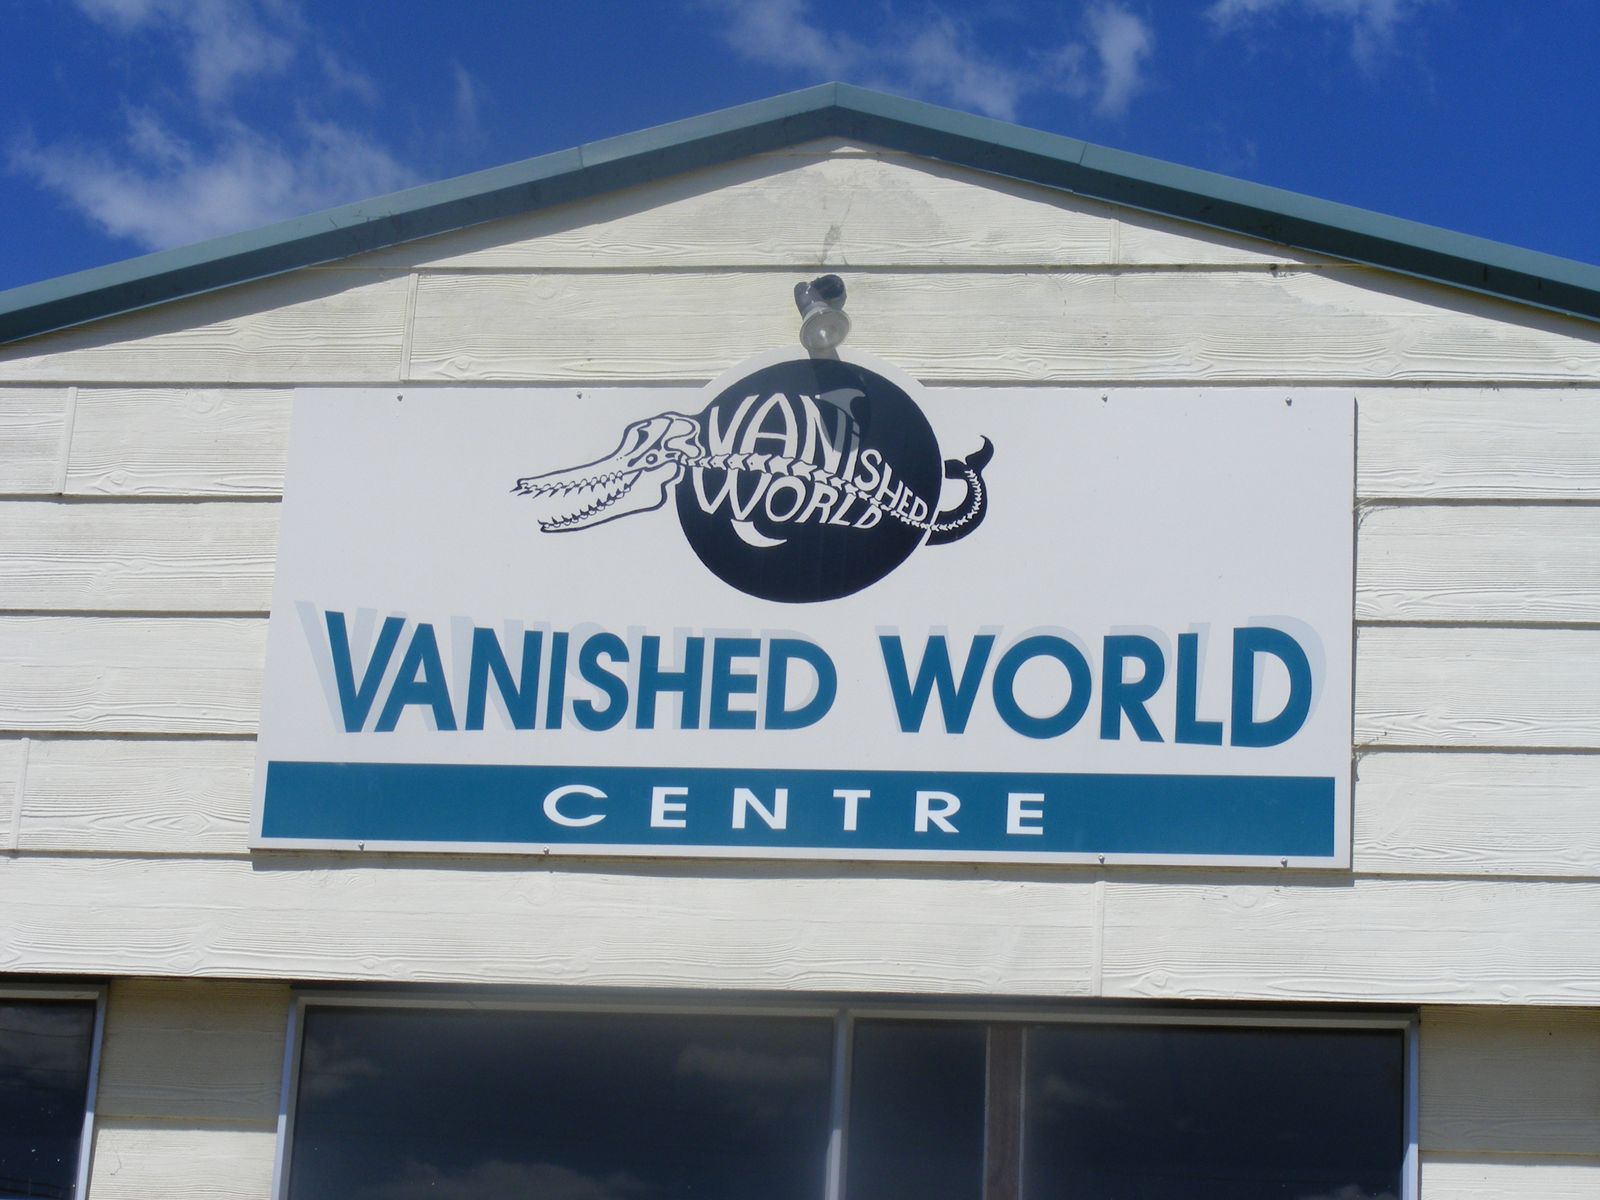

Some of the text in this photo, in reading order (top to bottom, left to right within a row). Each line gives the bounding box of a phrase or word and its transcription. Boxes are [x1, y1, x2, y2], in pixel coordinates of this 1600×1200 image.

[691, 466, 883, 529] WORLD
[325, 610, 1312, 748] VANISHED WORLD
[543, 784, 1045, 835] CENTRE
